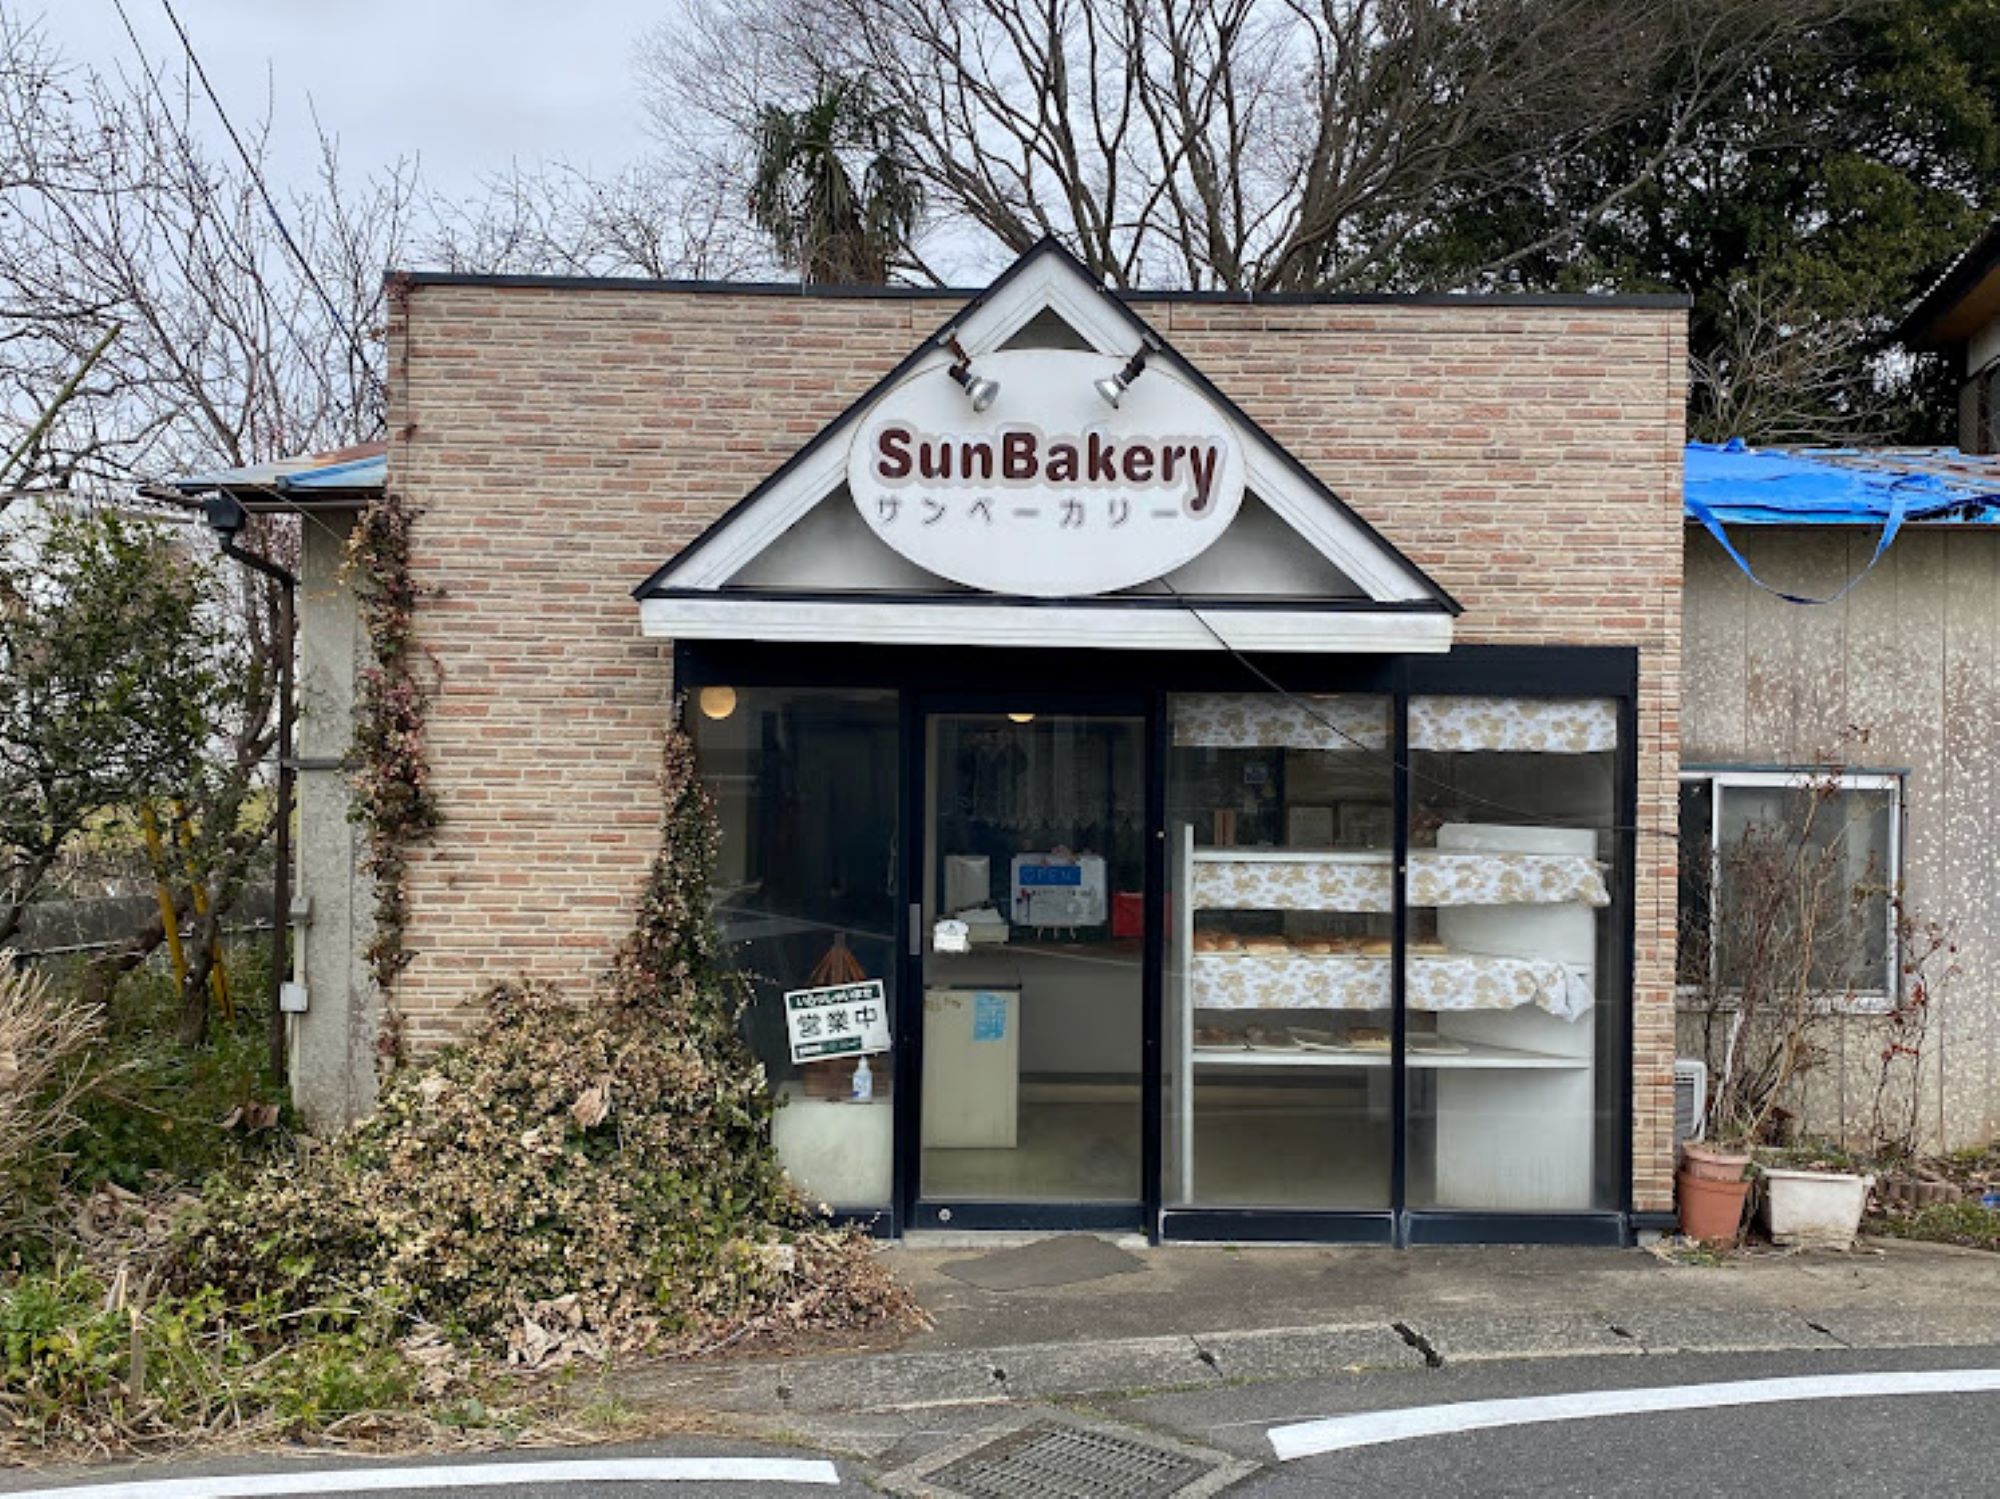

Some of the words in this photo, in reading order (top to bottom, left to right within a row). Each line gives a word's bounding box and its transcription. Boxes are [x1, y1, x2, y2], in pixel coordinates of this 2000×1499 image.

[878, 428, 1216, 511] SunBakery
[877, 498, 1178, 527] サンベーカリー
[796, 1005, 878, 1037] 営業中
